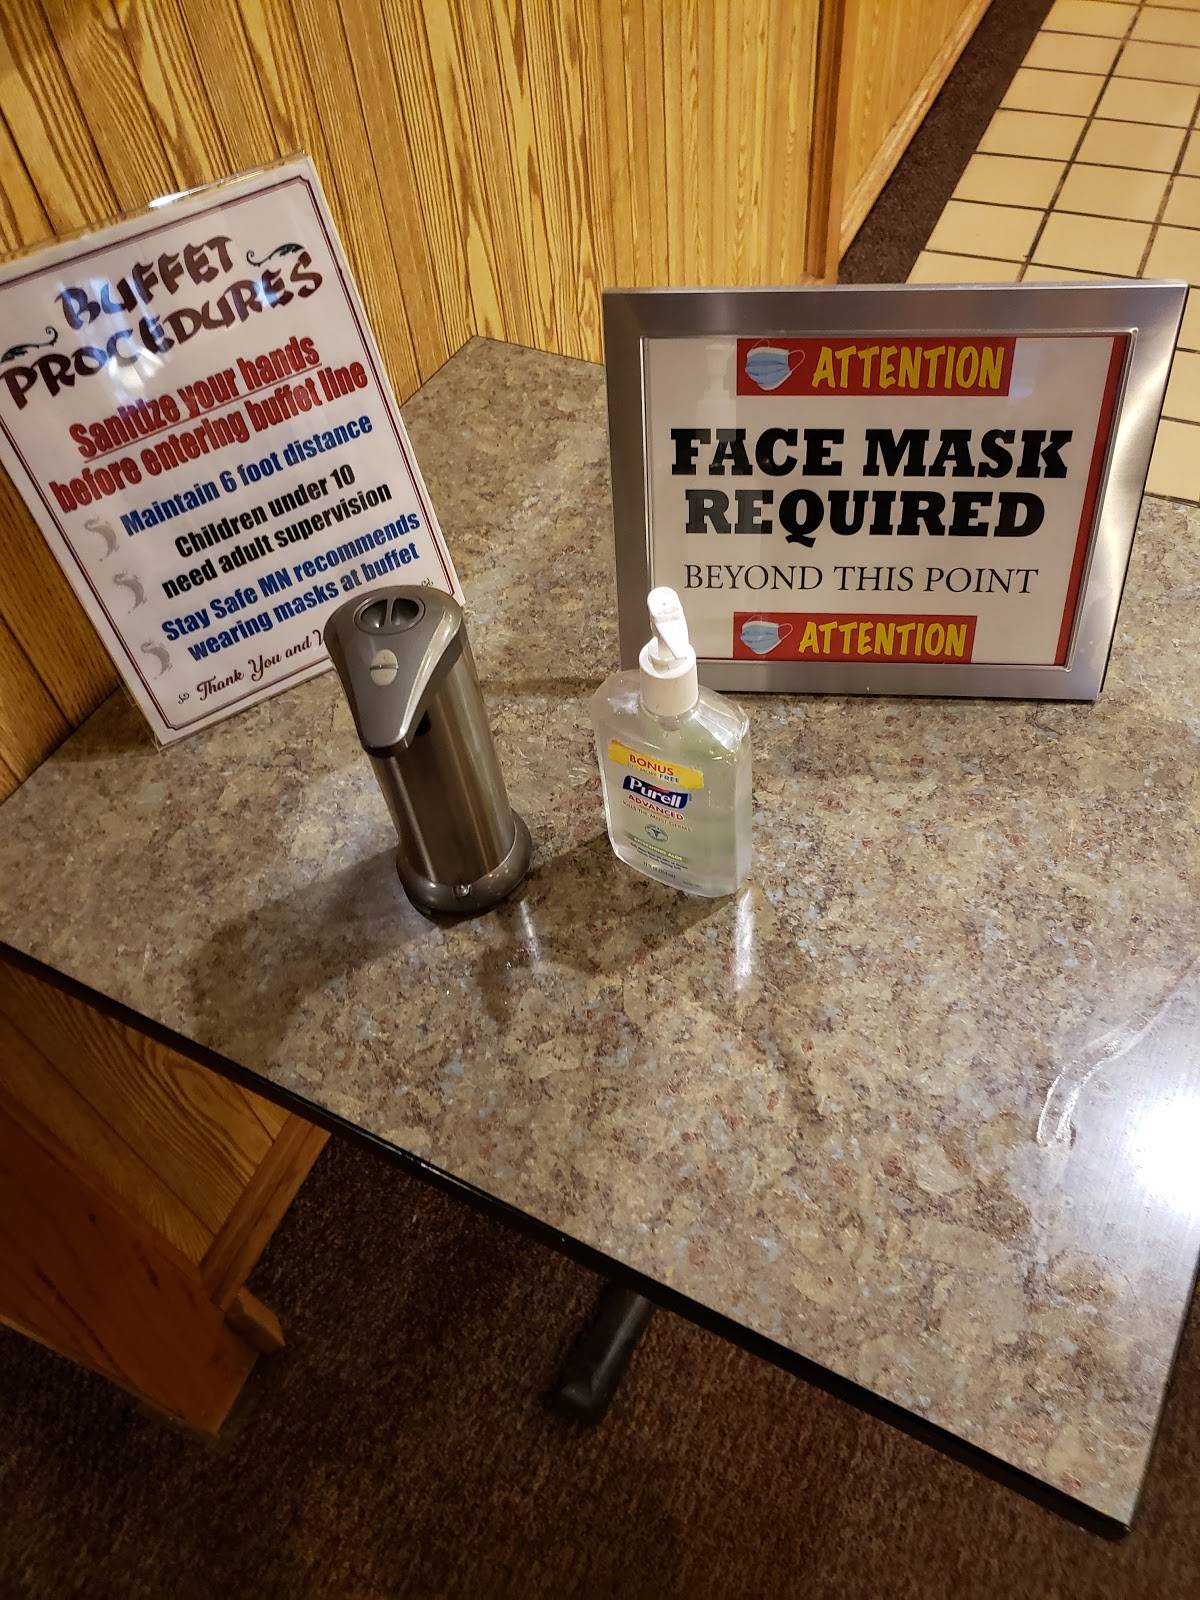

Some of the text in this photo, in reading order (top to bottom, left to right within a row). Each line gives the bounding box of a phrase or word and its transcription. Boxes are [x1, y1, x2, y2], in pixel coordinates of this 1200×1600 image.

[54, 236, 233, 330] BUFFET
[0, 250, 323, 411] PROCEDURES
[811, 345, 1007, 390] ATTENTION
[68, 335, 321, 458] Sanitize your hands
[49, 361, 368, 513] before entering buffet line
[119, 415, 373, 536] Maintain 6 foot distance
[670, 428, 1073, 480] FACE MASK
[161, 483, 393, 600] need adult supervision
[174, 464, 356, 558] Children under 10
[685, 489, 1045, 548] REQUIRED
[161, 512, 421, 642] Stay Safe MN recommends
[187, 610, 274, 662] wearing
[273, 581, 340, 624] masks
[339, 571, 362, 592] at
[360, 542, 421, 583] buffet
[684, 564, 1039, 595] BEYOND THIS POINT
[196, 669, 244, 701] Thank
[248, 654, 282, 682] You
[285, 635, 312, 658] and
[798, 621, 967, 657] ATTENTION
[629, 754, 675, 776] BONUS
[629, 777, 682, 808] Purell
[628, 794, 684, 820] ADVANCED
